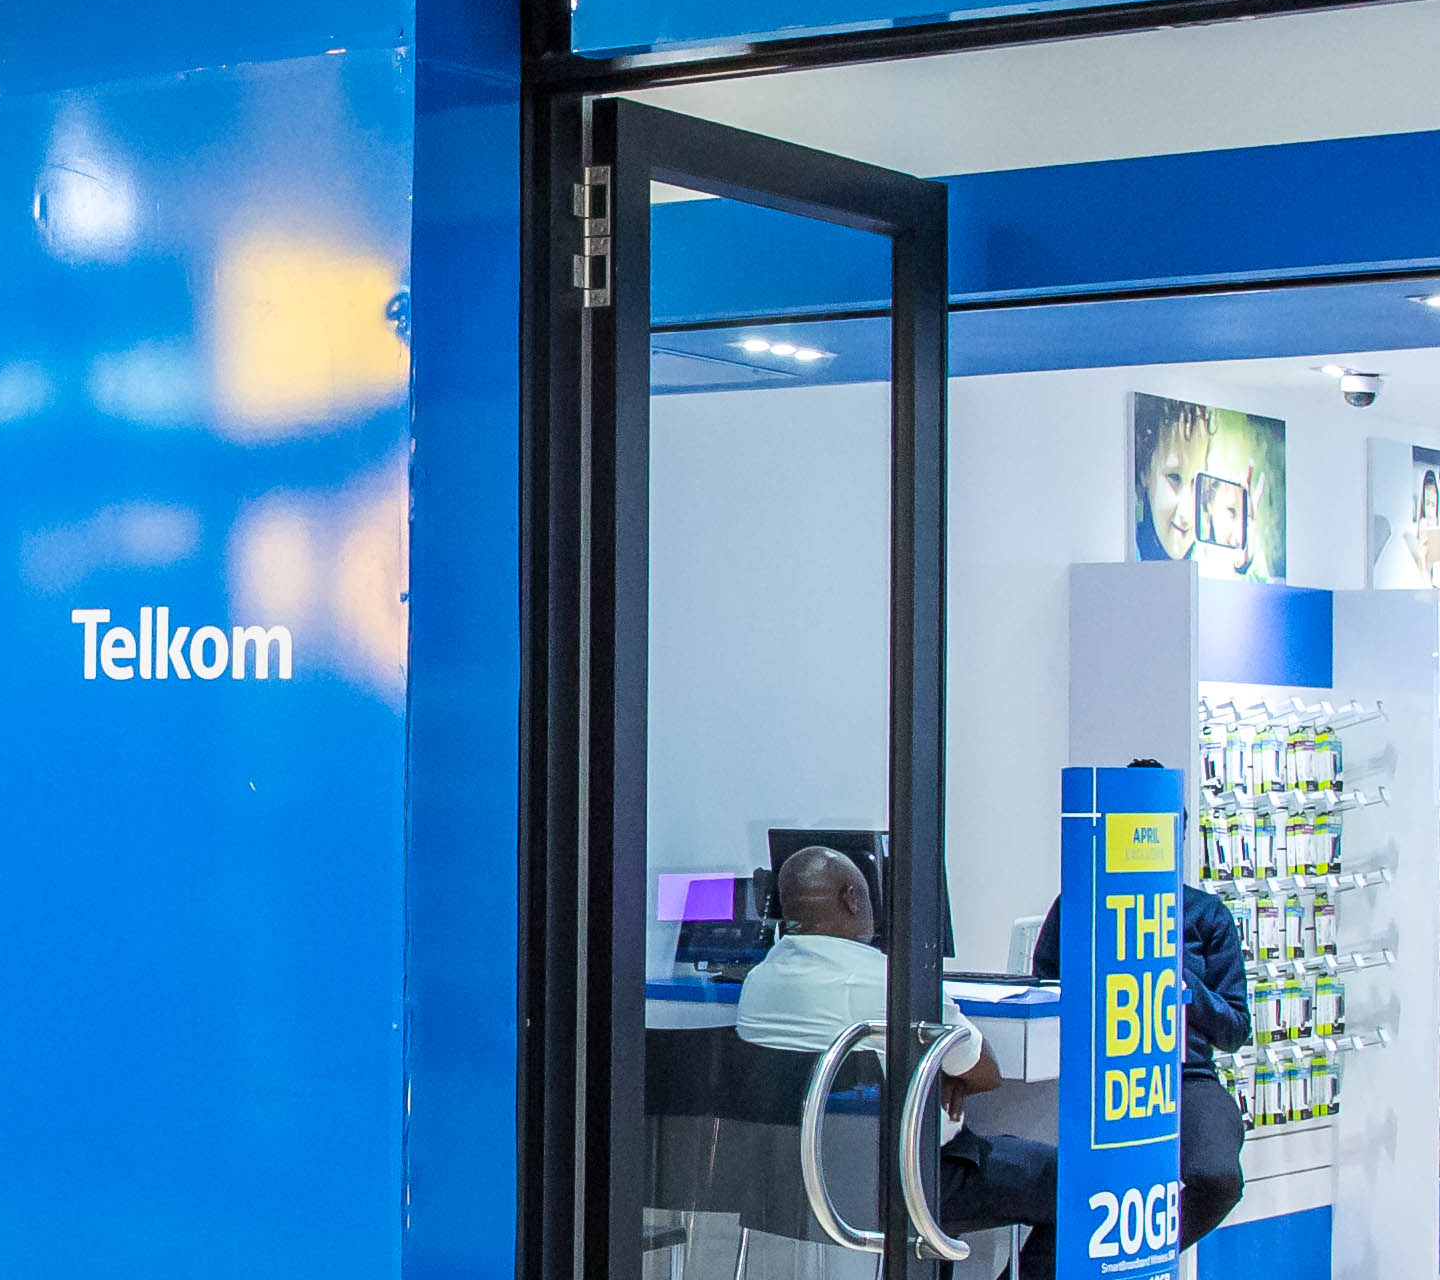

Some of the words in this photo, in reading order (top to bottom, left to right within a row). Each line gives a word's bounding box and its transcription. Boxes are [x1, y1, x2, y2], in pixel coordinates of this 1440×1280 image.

[71, 606, 293, 681] Telkom
[1132, 826, 1160, 844] APRIL
[1105, 892, 1176, 962] THE
[1105, 968, 1176, 1058] BIG
[1104, 1063, 1176, 1121] DEAL
[1089, 1180, 1180, 1259] 20GB
